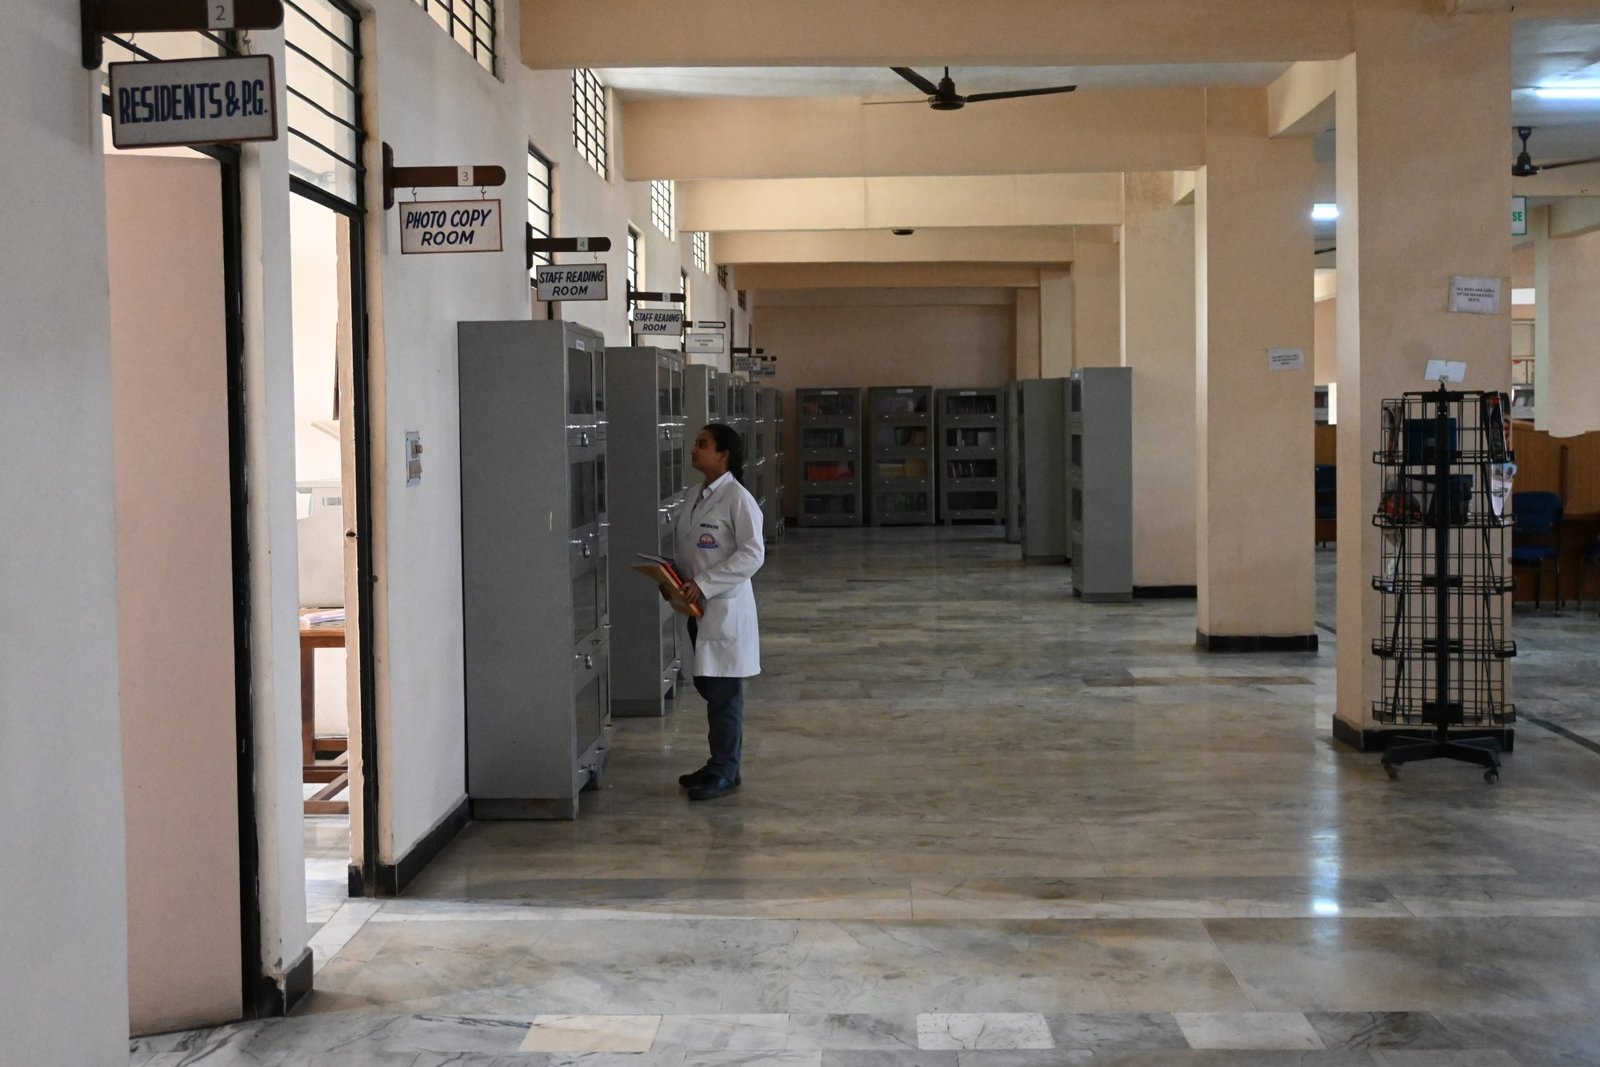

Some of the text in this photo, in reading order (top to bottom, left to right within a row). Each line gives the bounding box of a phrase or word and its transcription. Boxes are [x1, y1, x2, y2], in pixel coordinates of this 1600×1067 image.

[215, 5, 227, 21] 2
[118, 82, 223, 125] RESIDENTS
[462, 171, 469, 182] 3
[405, 208, 492, 230] PHOTO COPY
[420, 230, 475, 246] ROOM
[539, 270, 604, 284] STAFF READING
[552, 285, 588, 296] ROOM
[634, 312, 680, 322] STAFF READING
[642, 323, 667, 331] ROOM
